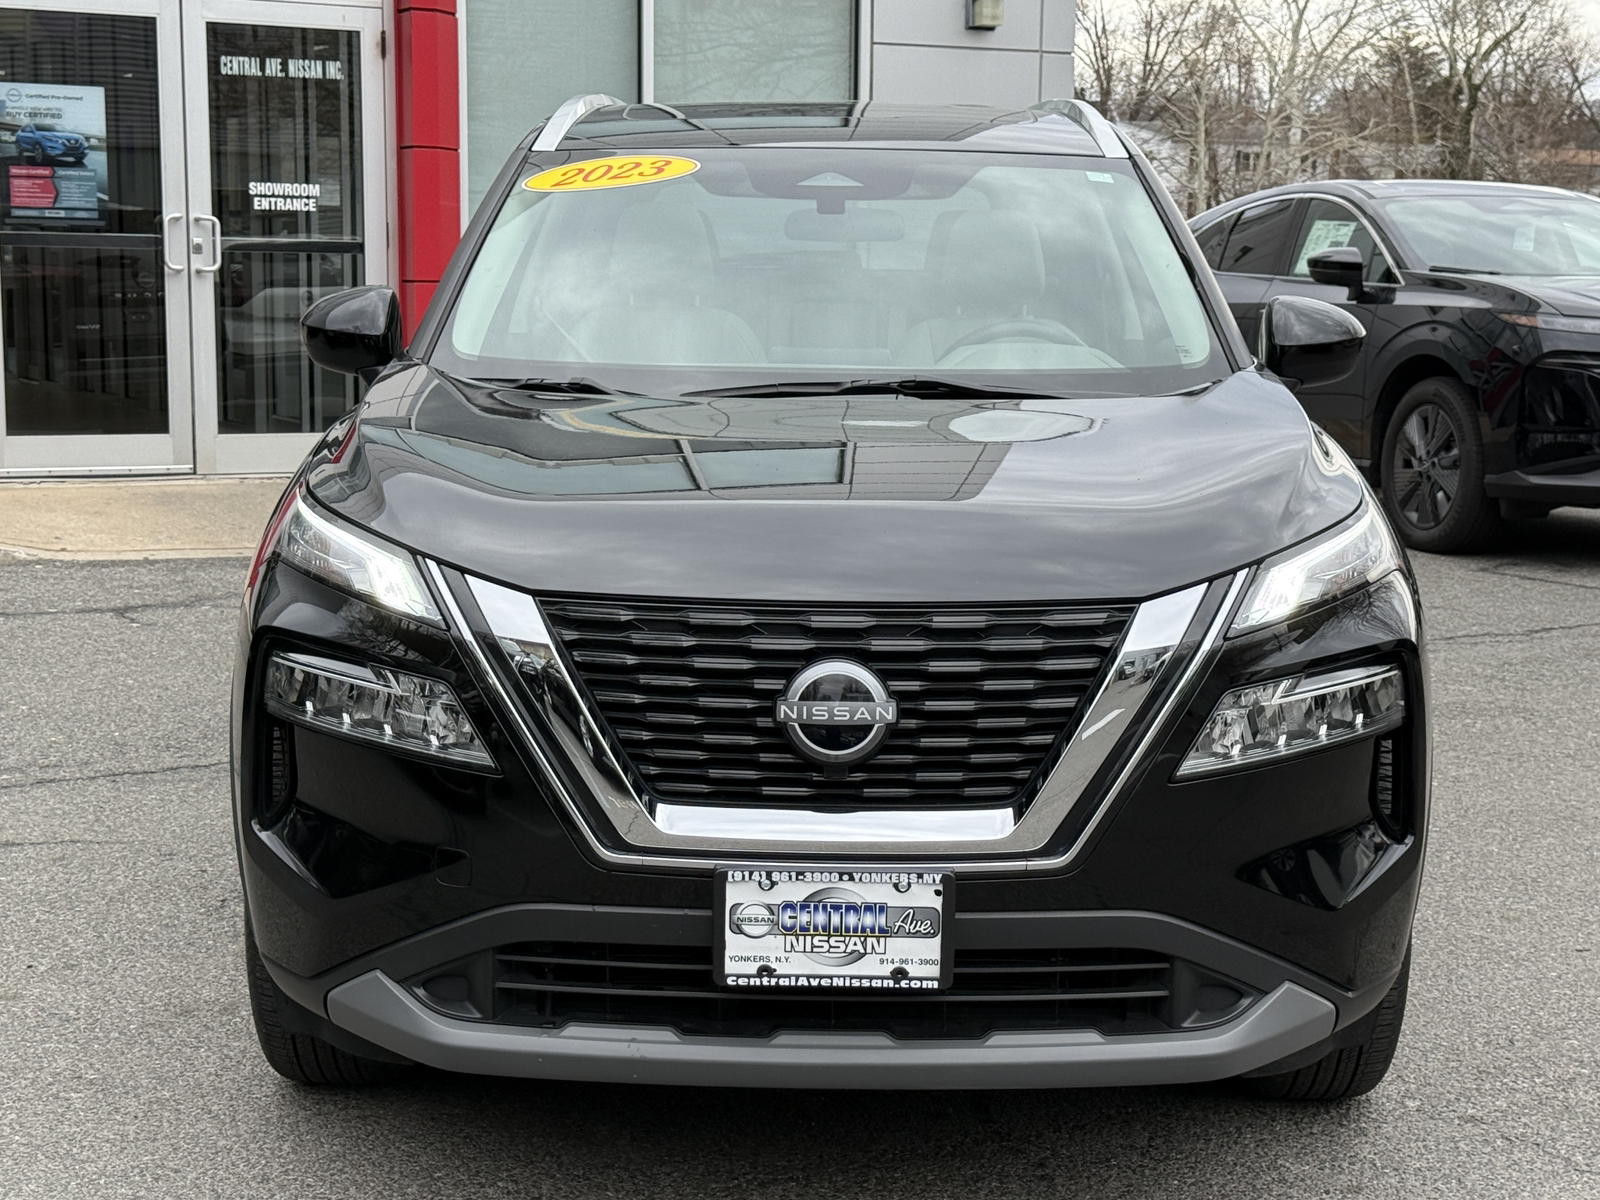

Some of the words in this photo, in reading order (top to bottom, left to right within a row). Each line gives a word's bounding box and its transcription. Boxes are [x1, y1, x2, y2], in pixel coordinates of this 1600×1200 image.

[220, 55, 262, 76] CENTRAL
[265, 57, 285, 77] AVE.
[288, 59, 323, 79] NISSAN
[325, 60, 345, 80] INC.
[550, 159, 672, 187] 2023
[248, 181, 320, 197] SHOWROOM
[253, 197, 317, 212] ENTRANCE
[780, 704, 893, 720] NISSAN
[771, 871, 840, 882] 961-3900
[778, 901, 891, 936] CENTRAL
[893, 908, 936, 935] Ave.
[784, 935, 887, 955] NISSAN
[728, 955, 773, 964] YONKERS,
[879, 958, 939, 966] 914-961-3900
[726, 976, 939, 989] CentralAveNissan.com
